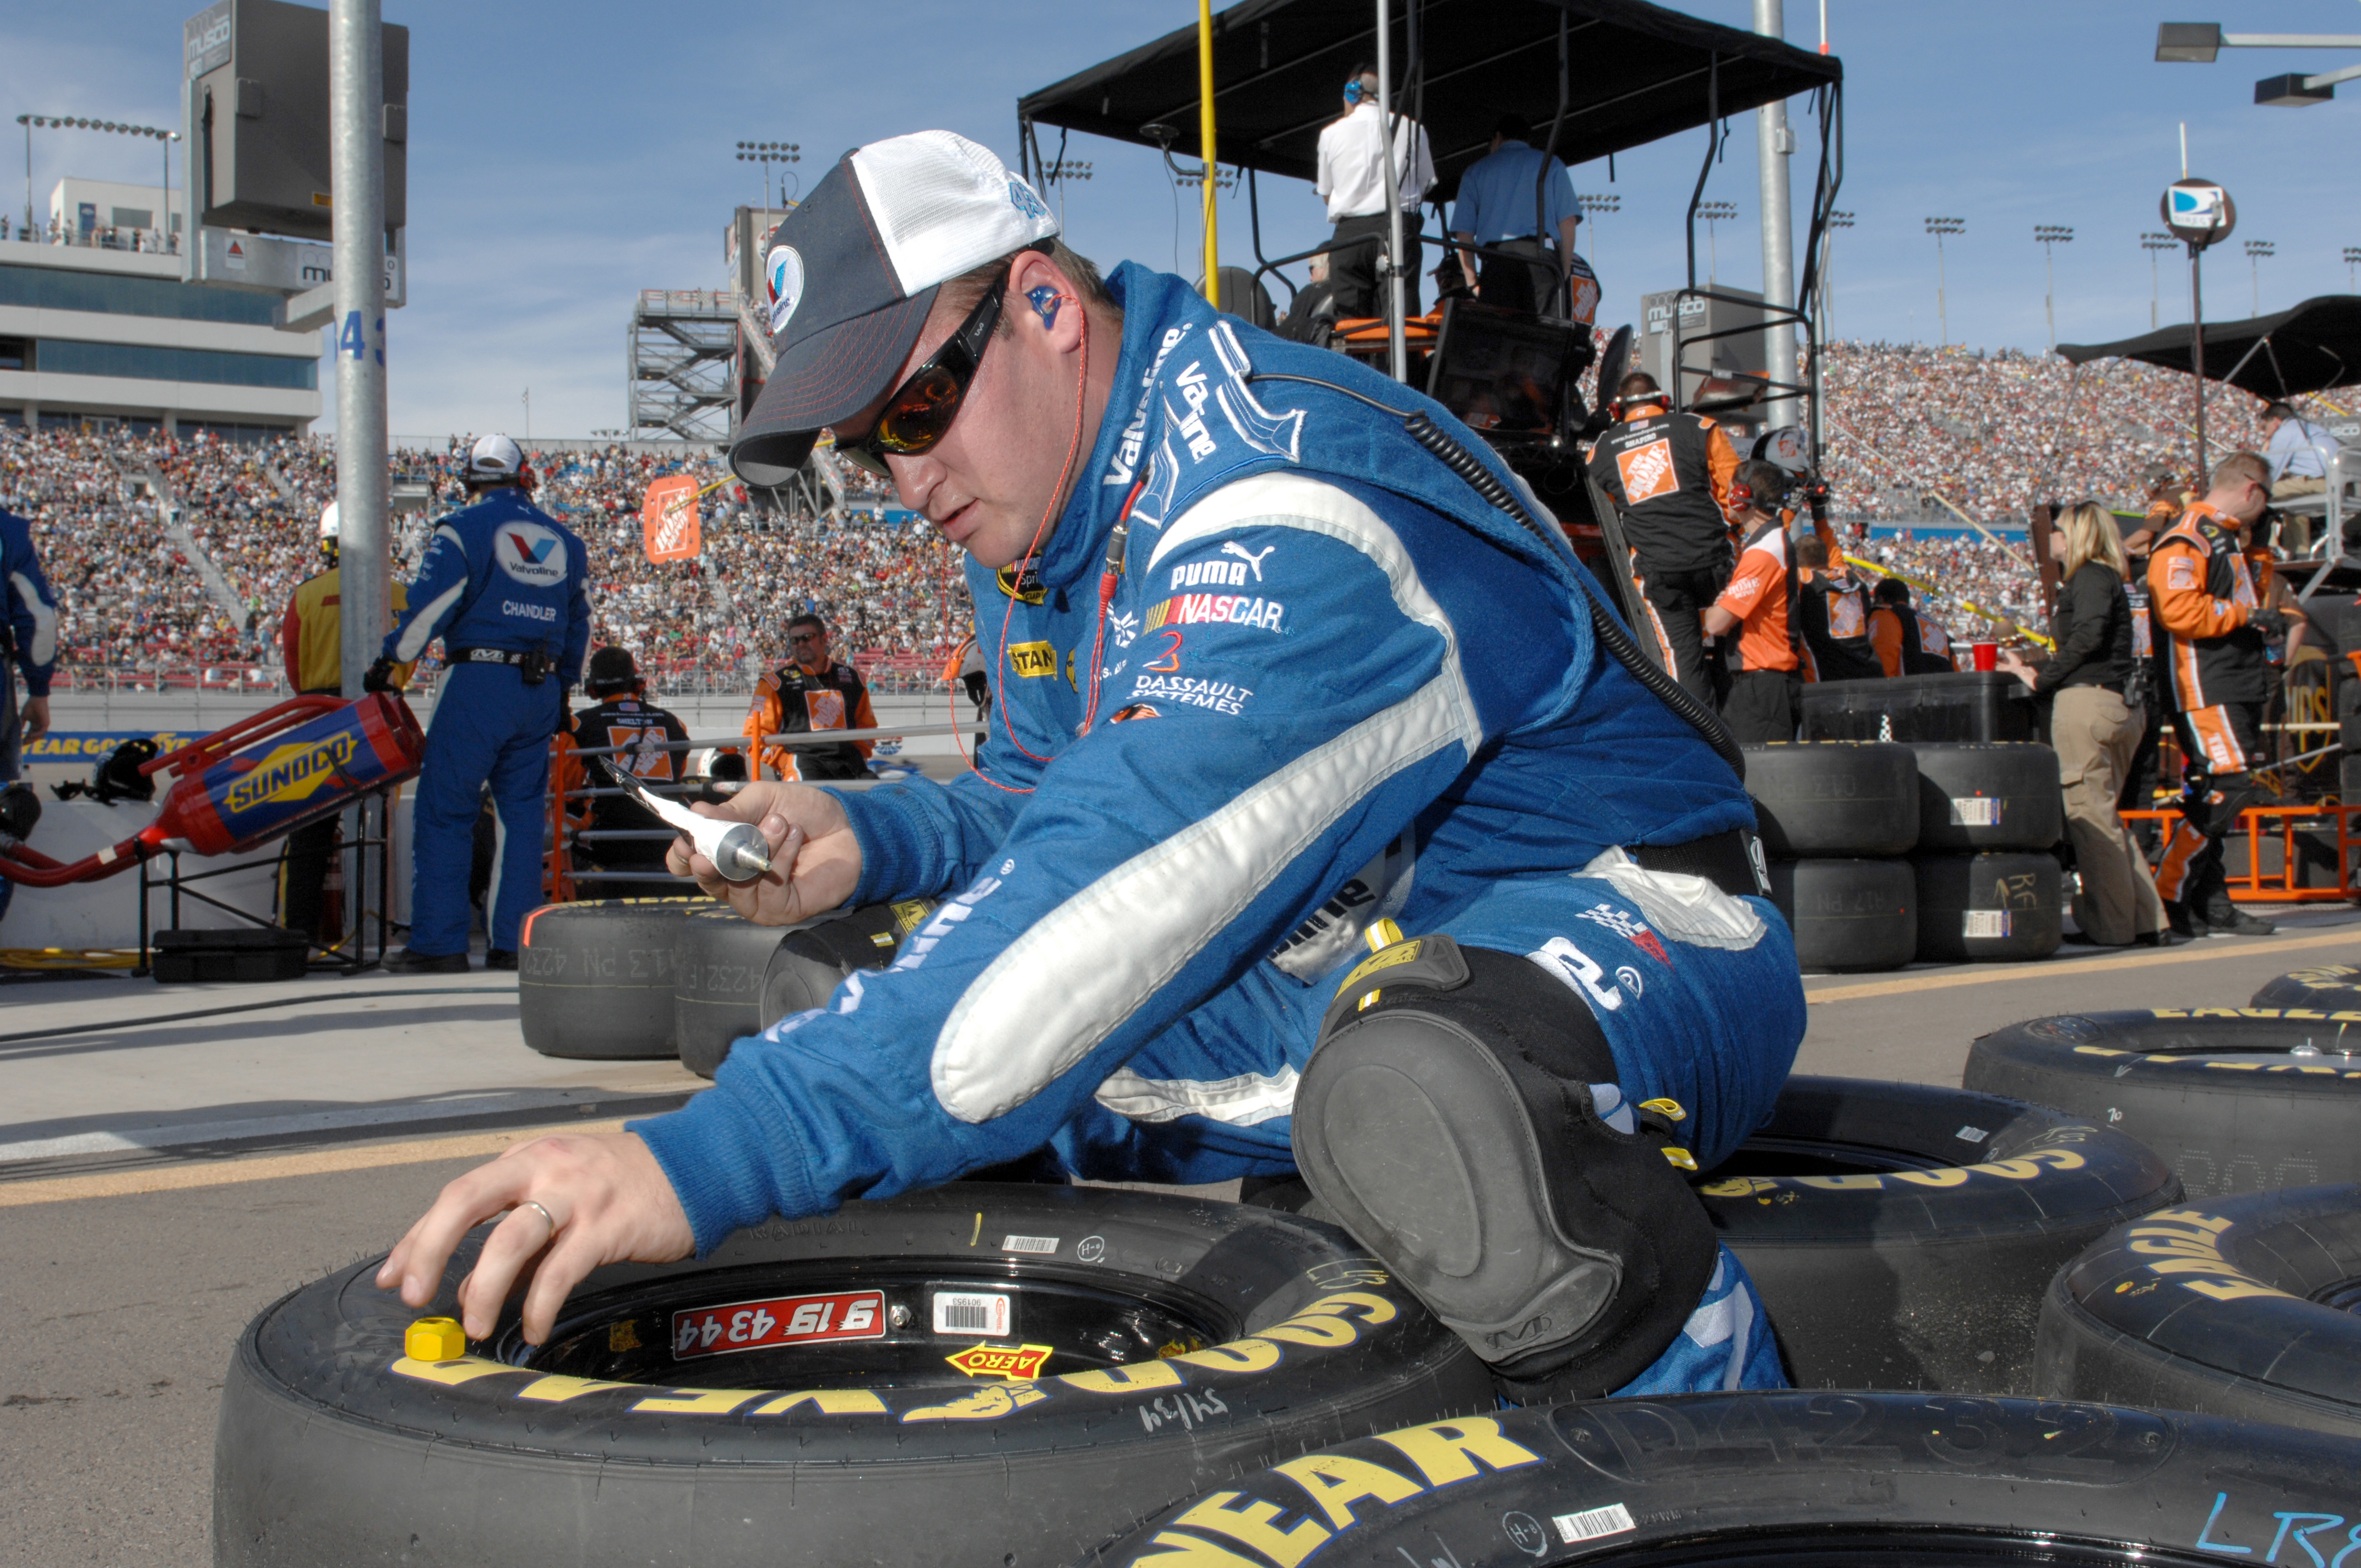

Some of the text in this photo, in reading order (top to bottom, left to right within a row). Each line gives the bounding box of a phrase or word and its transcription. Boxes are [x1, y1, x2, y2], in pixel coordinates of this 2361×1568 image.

[1625, 433, 1657, 449] SHAPIRO
[510, 562, 558, 577] Valvoline
[1171, 560, 1248, 590] PUMA
[503, 600, 557, 622] CHANDLER
[1177, 594, 1284, 633] NASCAR
[1136, 675, 1254, 703] DASSAULT
[232, 737, 349, 809] SUNOCO
[953, 1298, 981, 1306] 901953
[678, 1315, 724, 1352] 44
[728, 1308, 776, 1343] 43
[967, 1352, 1038, 1370] AERO
